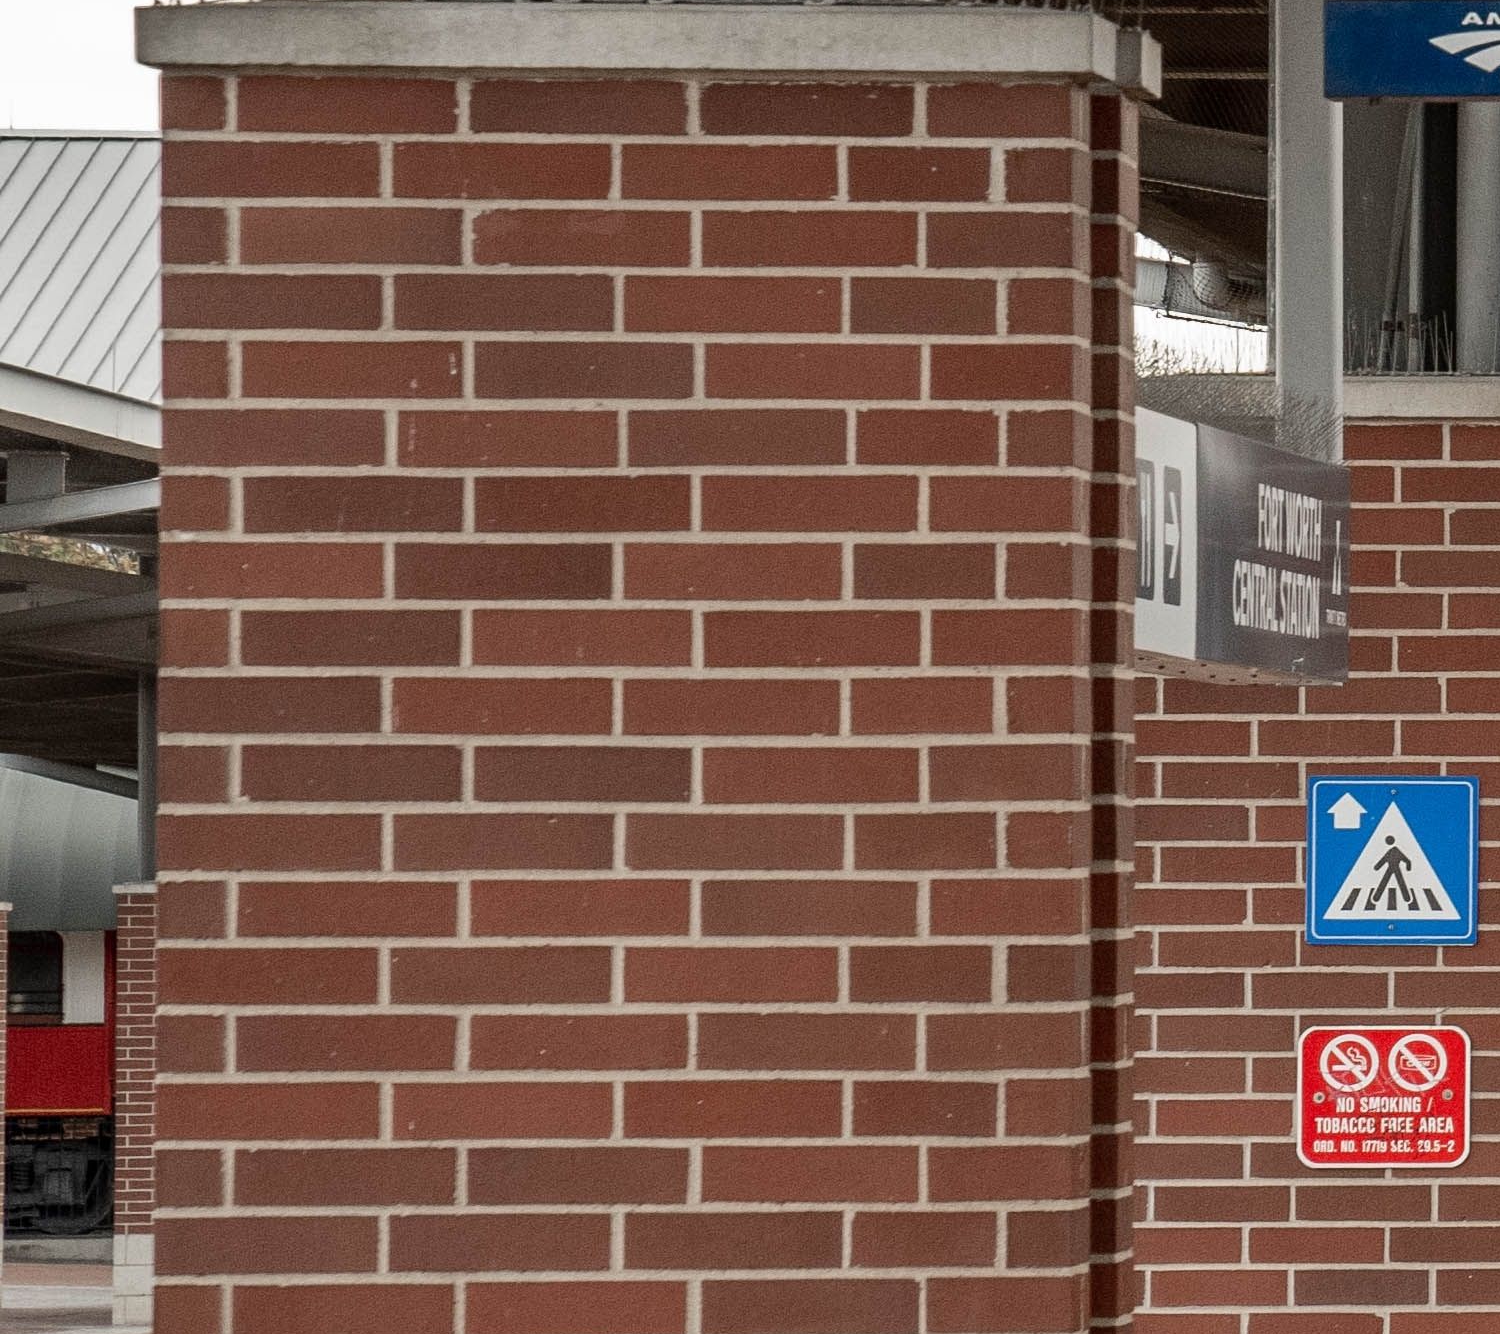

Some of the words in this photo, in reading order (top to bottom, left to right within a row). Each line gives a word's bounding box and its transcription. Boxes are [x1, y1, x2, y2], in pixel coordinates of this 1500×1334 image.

[1258, 482, 1285, 553] FORT
[1286, 490, 1323, 562] WORTH
[1232, 558, 1279, 633] CENTRAL
[1280, 568, 1321, 640] STATION
[1336, 1097, 1355, 1113] NO
[1359, 1096, 1421, 1113] SMOKING
[1314, 1117, 1376, 1134] TOBACCO
[1380, 1117, 1414, 1134] FREE
[1418, 1117, 1455, 1134] AREA
[1313, 1139, 1337, 1153] ORD.
[1340, 1139, 1358, 1153] NO.
[1390, 1139, 1414, 1153] SEC.
[1417, 1139, 1455, 1153] 29.5-2
